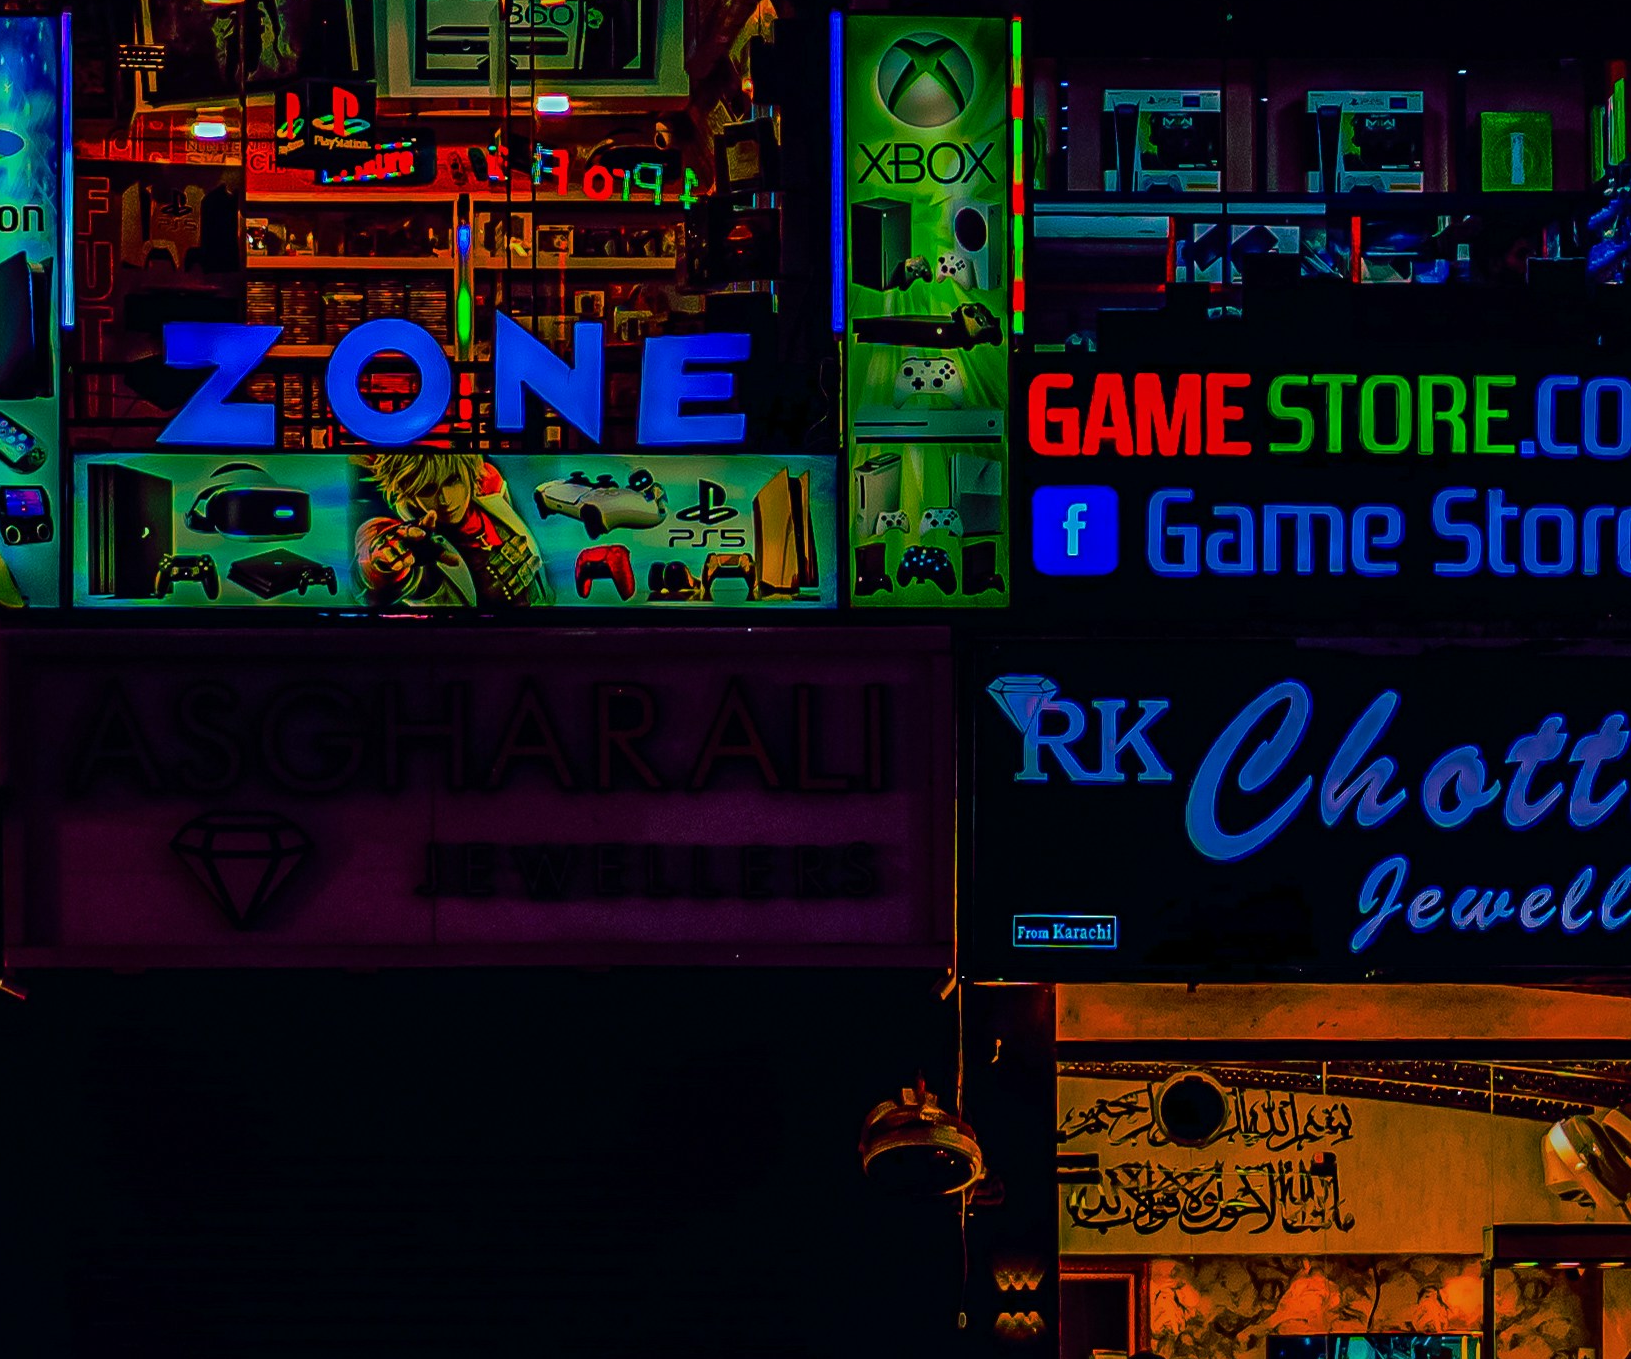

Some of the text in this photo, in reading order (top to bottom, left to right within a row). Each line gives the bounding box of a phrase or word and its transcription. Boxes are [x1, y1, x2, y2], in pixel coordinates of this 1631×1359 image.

[857, 141, 998, 185] XBOX
[155, 308, 751, 447] ZONE
[1027, 372, 1252, 457] GAME
[669, 529, 745, 547] PS5
[1147, 488, 1405, 577] Game
[1015, 697, 1172, 784] RK
[1017, 923, 1112, 941] From Karachi
